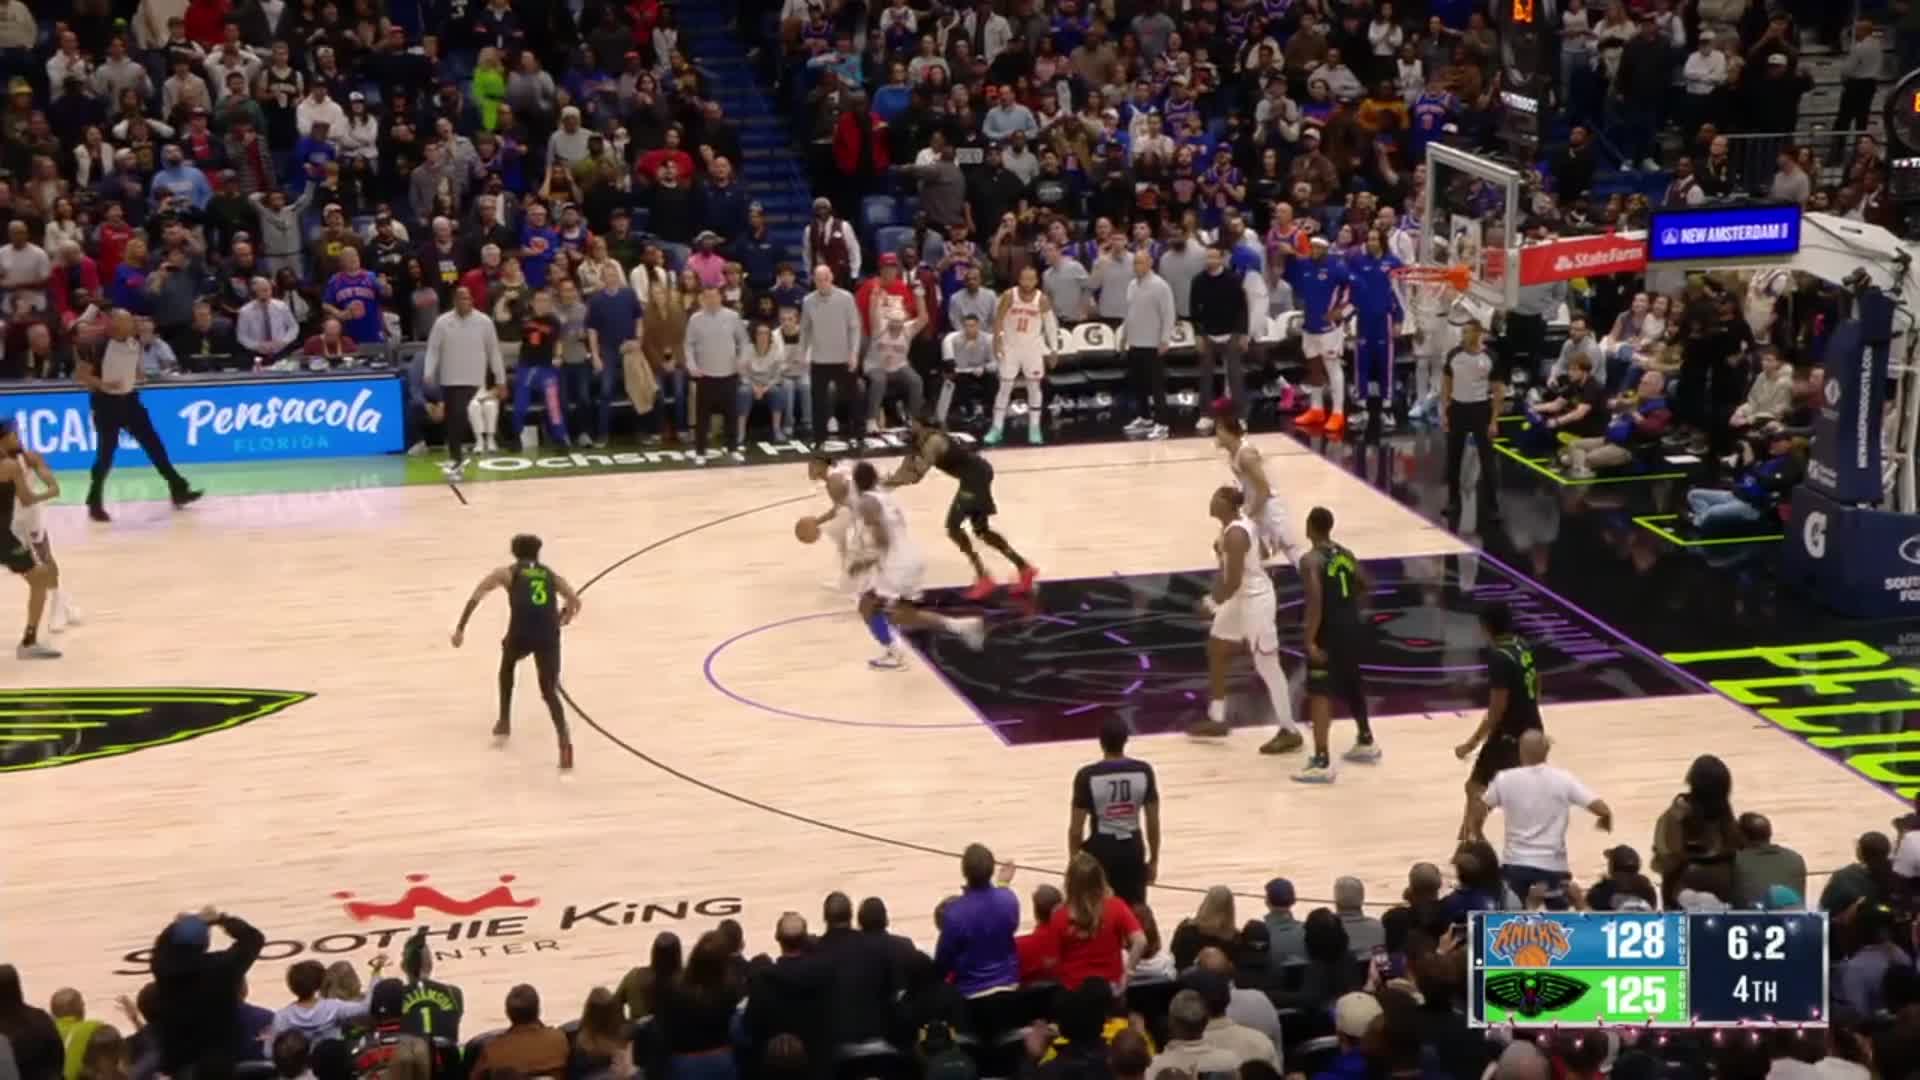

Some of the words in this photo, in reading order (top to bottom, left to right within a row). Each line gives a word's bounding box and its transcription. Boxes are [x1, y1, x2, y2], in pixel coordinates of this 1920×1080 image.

[1681, 227, 1708, 244] NEW
[1707, 222, 1779, 243] AMSTERDAM
[177, 388, 382, 447] Pensacola
[233, 435, 329, 453] FLORIDA
[1804, 511, 1827, 558] G
[531, 580, 548, 606] 3
[1339, 570, 1349, 598] 1
[1108, 779, 1131, 802] 70
[112, 915, 529, 975] SOOTHIE
[367, 939, 561, 969] CNTER
[420, 1006, 431, 1034] 1
